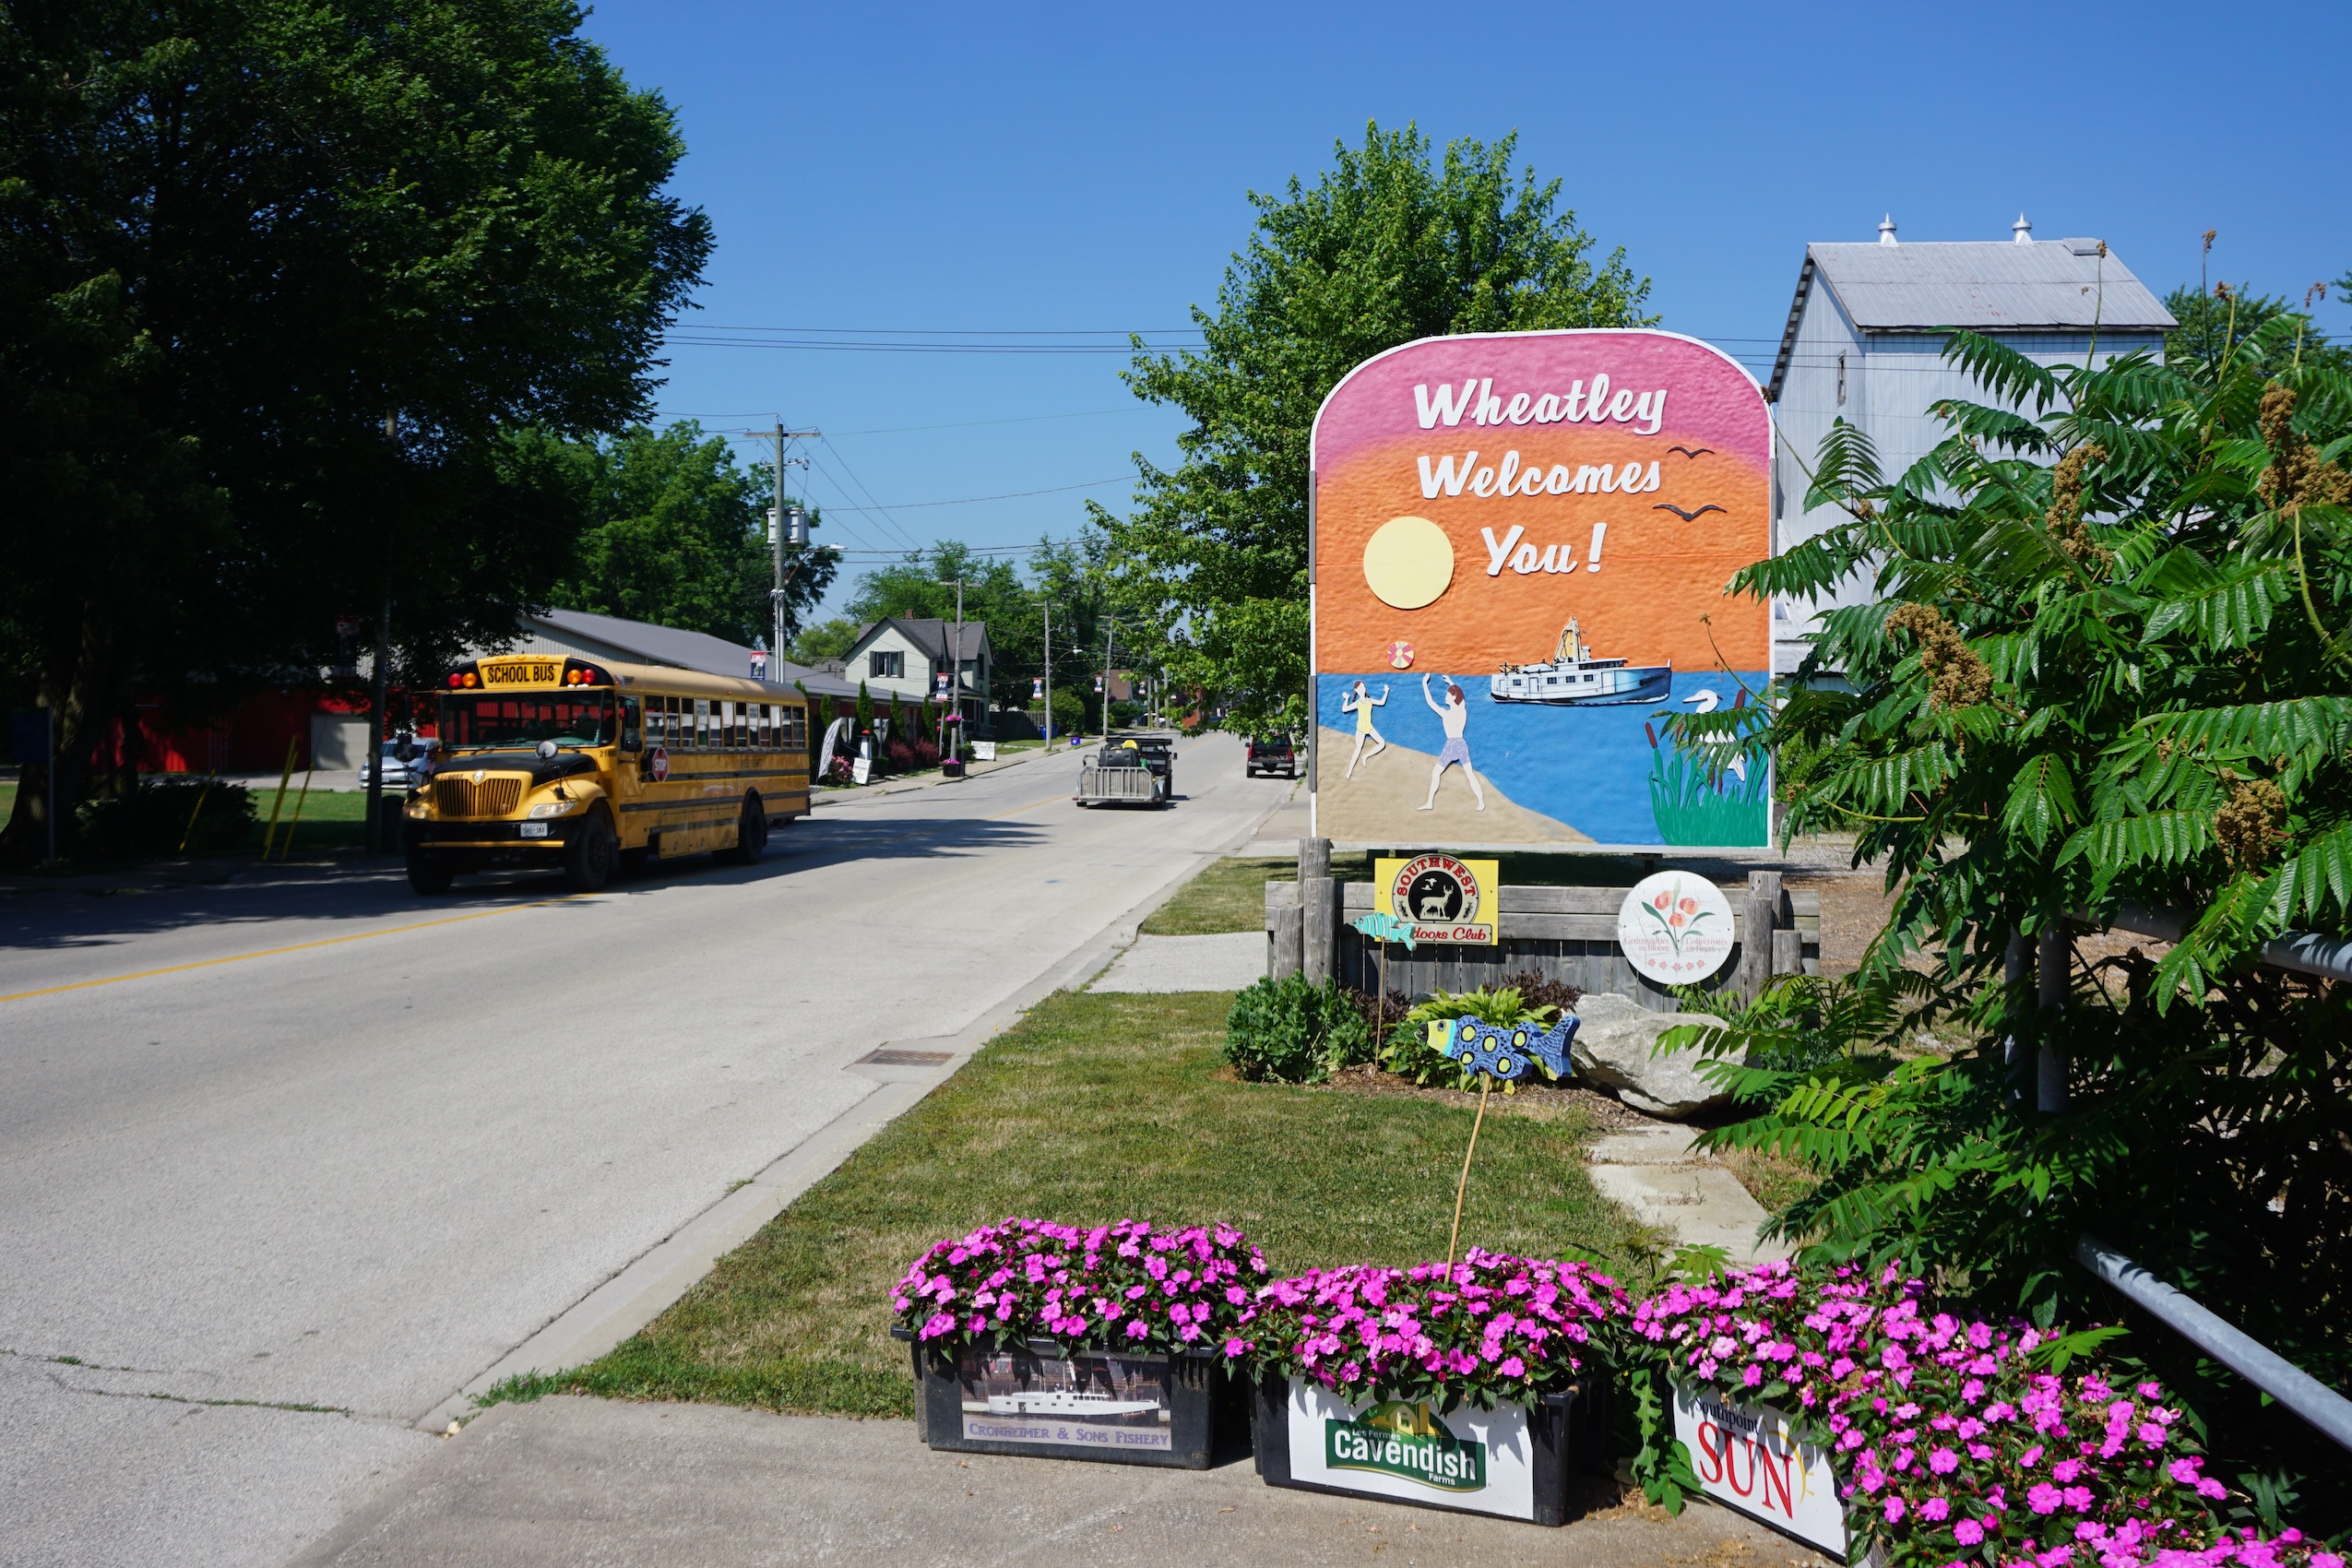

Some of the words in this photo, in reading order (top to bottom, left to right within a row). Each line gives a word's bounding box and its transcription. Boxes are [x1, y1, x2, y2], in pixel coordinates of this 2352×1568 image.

[1414, 374, 1668, 435] Wheatley
[1417, 450, 1660, 499] Welcomes
[488, 666, 529, 683] SCHOOL
[533, 664, 554, 682] BUS
[654, 759, 667, 772] STOP
[1396, 857, 1476, 897] SOUTHWEST
[1414, 927, 1448, 940] doors
[1453, 927, 1486, 940] Club
[1624, 936, 1669, 945] Communities
[1647, 944, 1669, 952] Bloom
[1695, 1397, 1759, 1435] Southpoint
[968, 1423, 1050, 1439] CRONHEIMER
[1057, 1427, 1069, 1440] &
[1076, 1428, 1108, 1443] SONS
[1115, 1431, 1169, 1445] FISHERY
[1352, 1429, 1367, 1437] Les
[1369, 1430, 1401, 1441] Fermes
[1335, 1430, 1476, 1480] Cavendish
[1429, 1473, 1455, 1486] Farms
[1698, 1420, 1793, 1520] SUN
